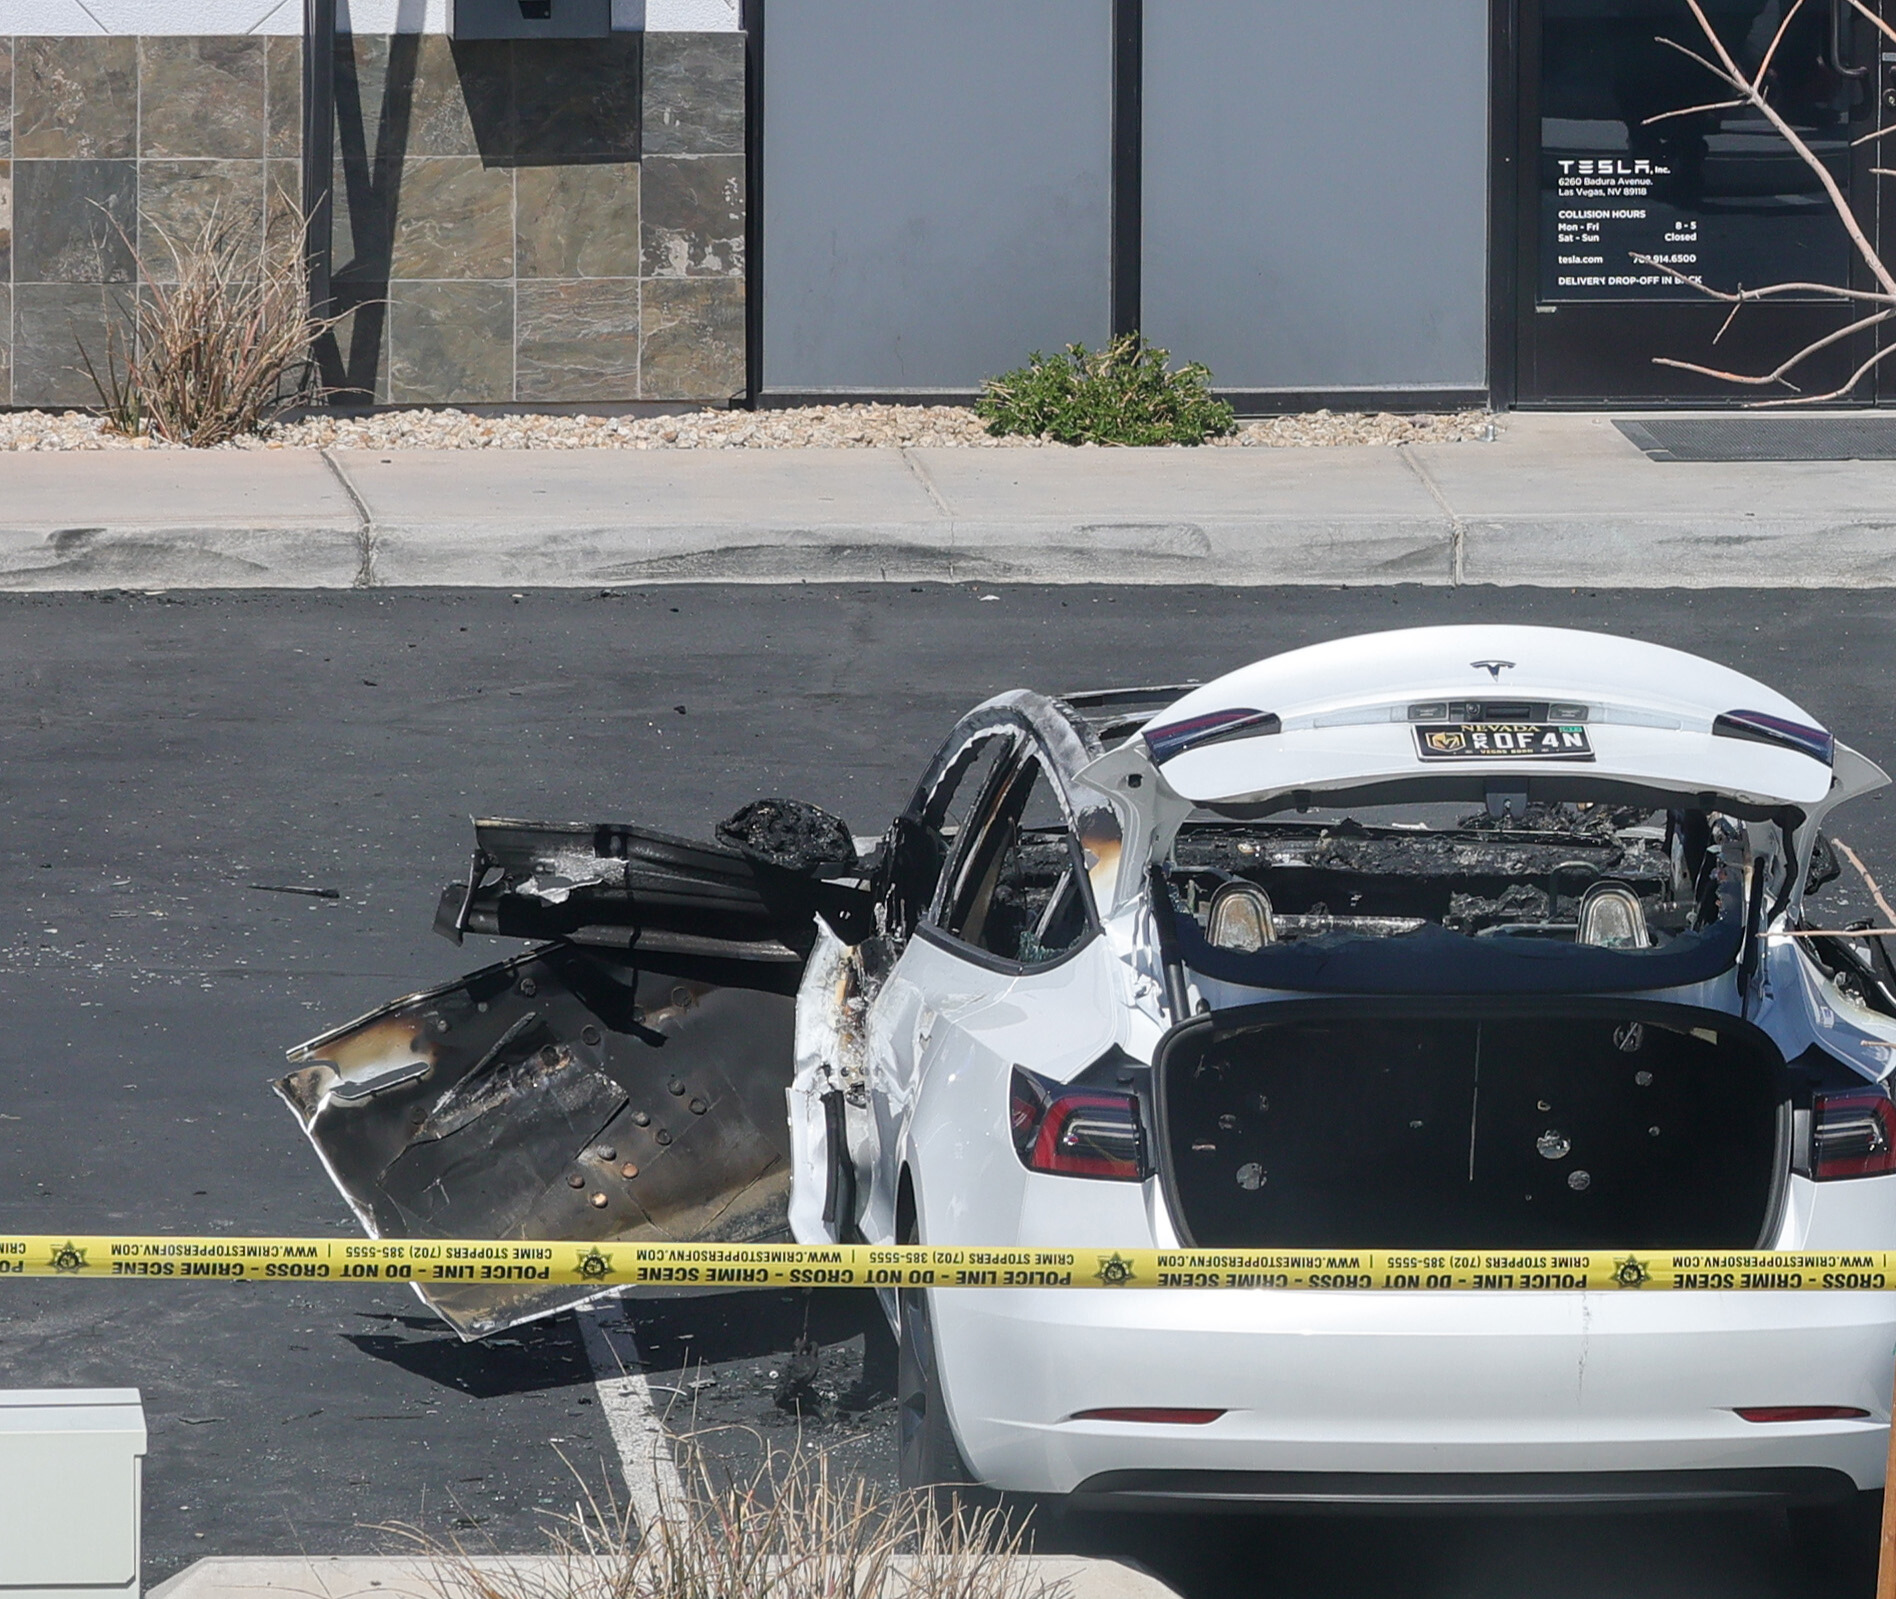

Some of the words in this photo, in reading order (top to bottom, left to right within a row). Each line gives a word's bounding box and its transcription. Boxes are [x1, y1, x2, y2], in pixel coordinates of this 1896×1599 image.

[1655, 166, 1671, 174] Inc.
[1558, 178, 1582, 186] 6260
[1584, 177, 1615, 186] Badura
[1558, 188, 1574, 196] Las
[1576, 188, 1605, 197] Vegas,
[1607, 188, 1621, 196] NV
[1623, 188, 1647, 196] 89118
[1558, 210, 1610, 218] COLLISION
[1612, 210, 1646, 218] HOURS
[1558, 223, 1578, 231] Mon
[1586, 222, 1599, 231] Fri
[1558, 233, 1574, 242] Sat
[1581, 233, 1600, 242] Sun
[1664, 233, 1697, 241] Closed
[1558, 255, 1603, 264] tesla.com
[1558, 277, 1605, 285] DELIVERY
[1608, 276, 1659, 285] DROP-OFF
[1662, 276, 1672, 284] IN
[111, 1244, 318, 1257] WWW.CRIMESTOPPERSOFNV.COM
[346, 1246, 404, 1258] 385-5555
[409, 1247, 441, 1258] (702)
[446, 1247, 508, 1259] STOPPERS
[513, 1248, 552, 1259] CRIME
[637, 1250, 842, 1263] WWW.CRIMESTOPPERSOFNV.COM
[870, 1252, 927, 1263] 385-5555
[933, 1253, 964, 1264] (702)
[969, 1253, 1030, 1264] STOPPERS
[1035, 1254, 1074, 1265] CRIME
[112, 1262, 174, 1275] SCENE
[181, 1263, 244, 1276] CRIME
[265, 1263, 330, 1277] CROSS
[340, 1264, 379, 1277] NOT
[385, 1264, 411, 1278] DO
[433, 1265, 474, 1278] LINE
[481, 1266, 549, 1279] POLICE
[637, 1267, 699, 1281] SCENE
[705, 1268, 768, 1282] CRIME
[790, 1269, 853, 1283] CROSS
[864, 1270, 902, 1283] NOT
[909, 1270, 934, 1284] DO
[956, 1271, 997, 1284] LINE
[1003, 1271, 1071, 1285] POLICE
[1158, 1273, 1220, 1286] SCENE
[1226, 1274, 1288, 1287] CRIME
[1309, 1274, 1372, 1288] CROSS
[1382, 1275, 1420, 1288] NOT
[1426, 1275, 1452, 1288] DO
[1472, 1275, 1513, 1288] LINE
[1520, 1274, 1587, 1288] POLICE
[1673, 1274, 1734, 1288] SCENE
[1740, 1274, 1802, 1288] CRIME
[1823, 1274, 1885, 1288] CROSS
